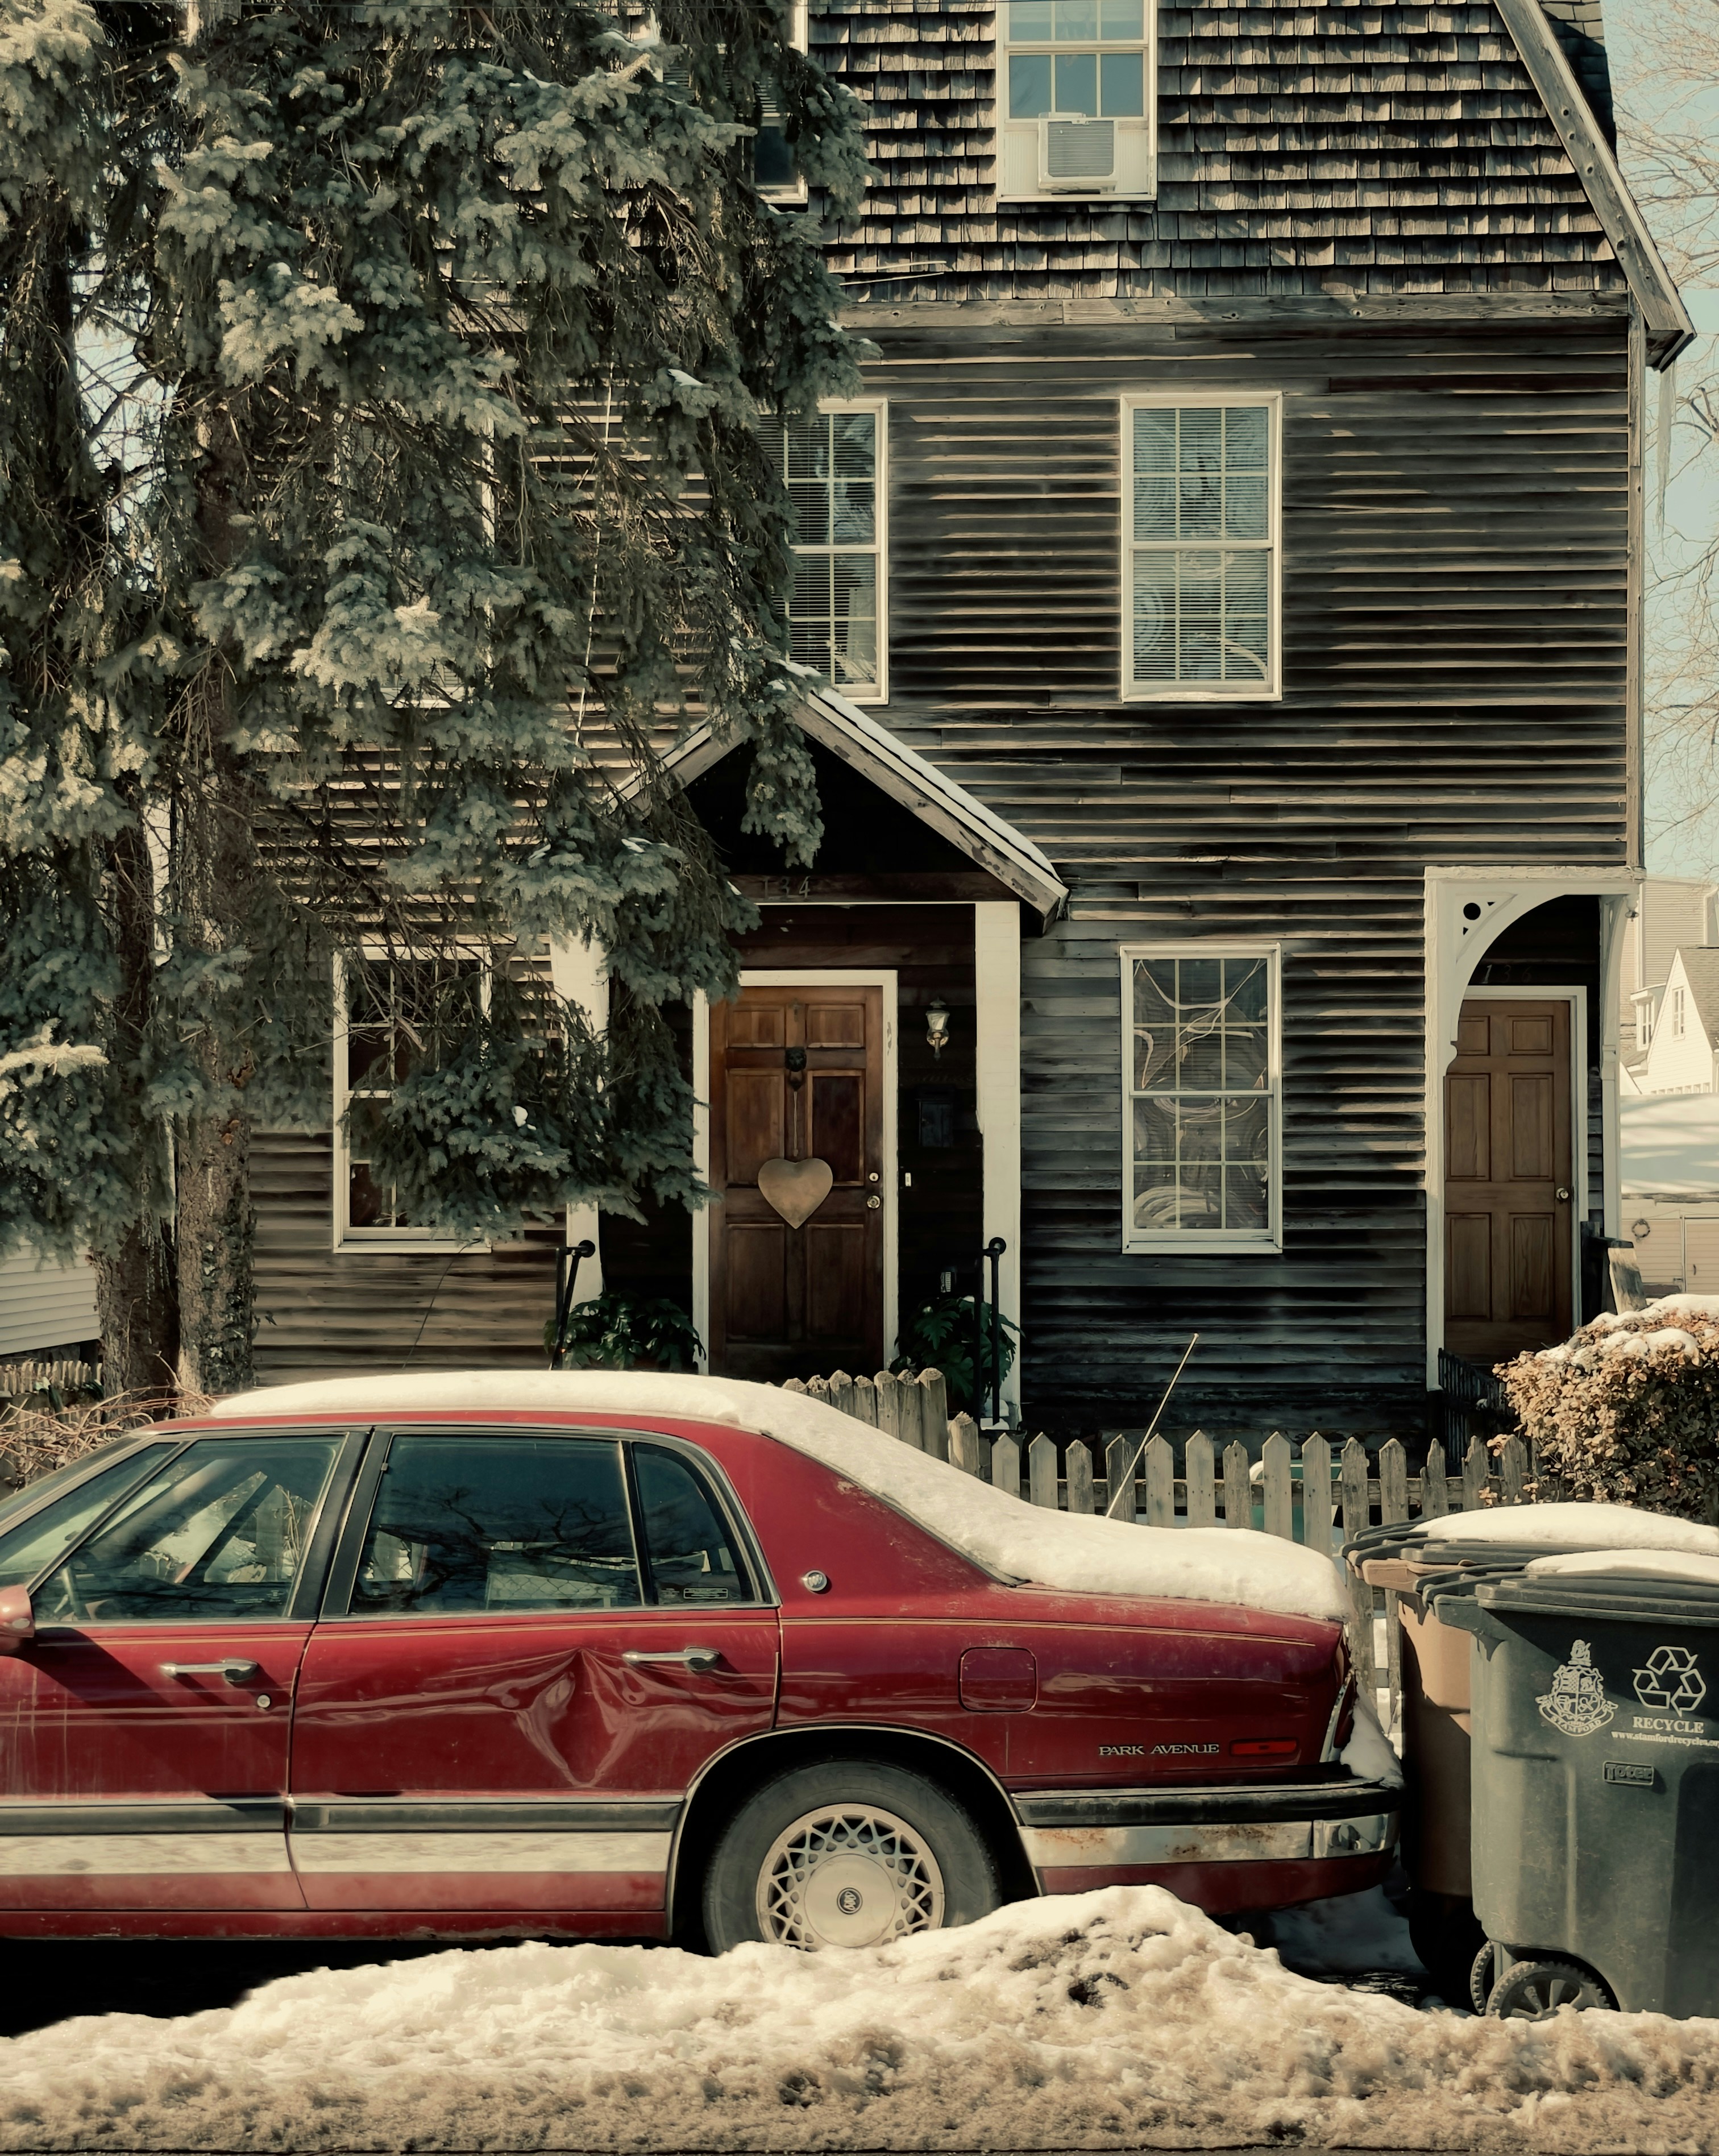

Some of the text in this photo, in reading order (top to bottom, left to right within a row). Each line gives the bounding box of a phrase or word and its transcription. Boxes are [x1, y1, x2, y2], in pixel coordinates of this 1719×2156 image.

[1482, 964, 1532, 984] 136
[1550, 1715, 1602, 1733] STAMFORD
[1633, 1716, 1704, 1734] RECYCLE
[1098, 1744, 1220, 1756] PARK AVENUE
[1605, 1763, 1652, 1780] Toter
